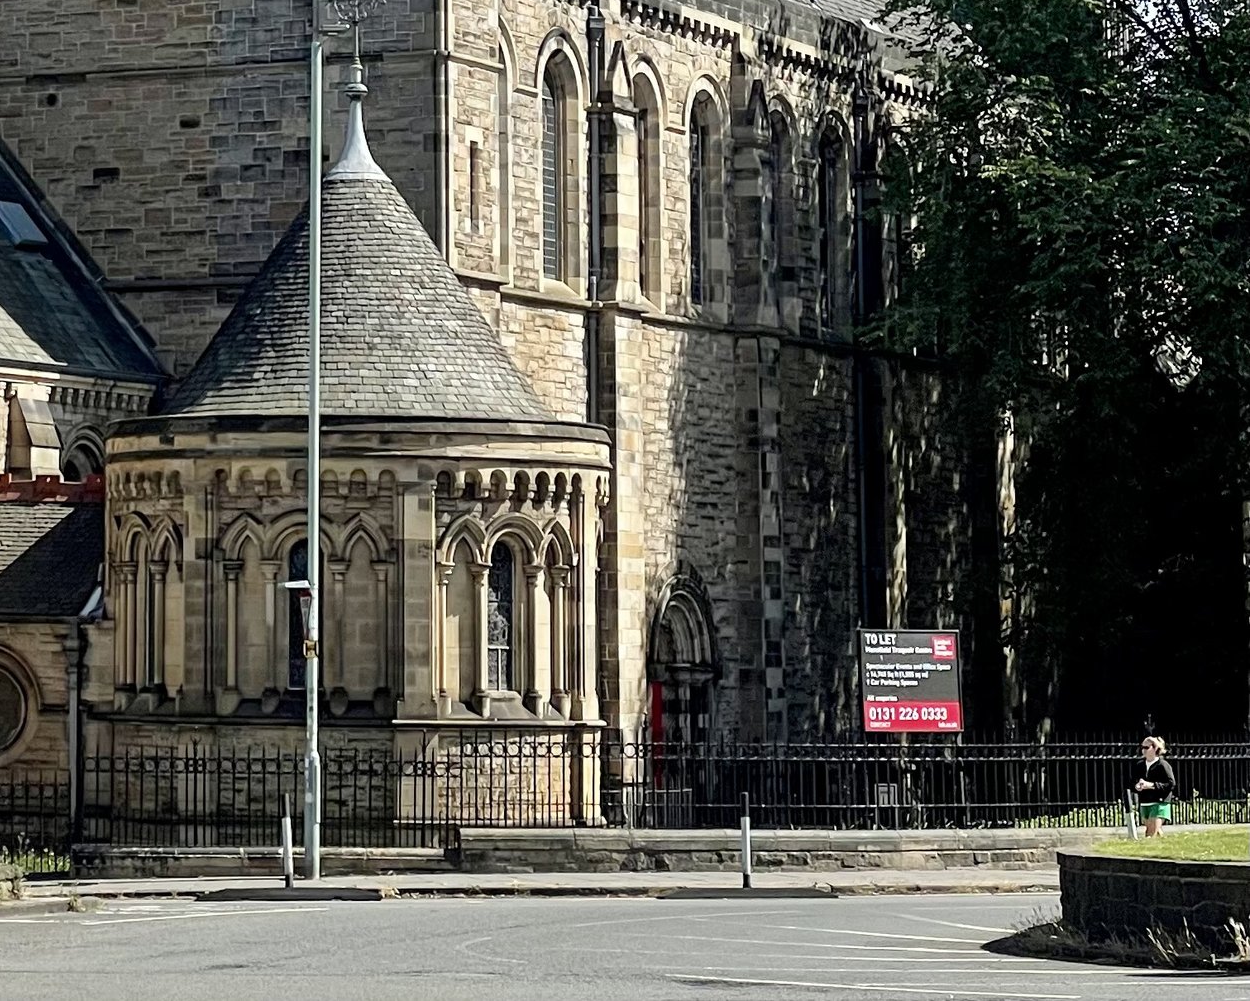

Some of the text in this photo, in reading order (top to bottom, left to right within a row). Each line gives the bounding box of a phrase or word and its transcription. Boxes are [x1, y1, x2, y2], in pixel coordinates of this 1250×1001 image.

[865, 633, 897, 645] TO LET
[869, 707, 947, 720] 0131 226 0333
